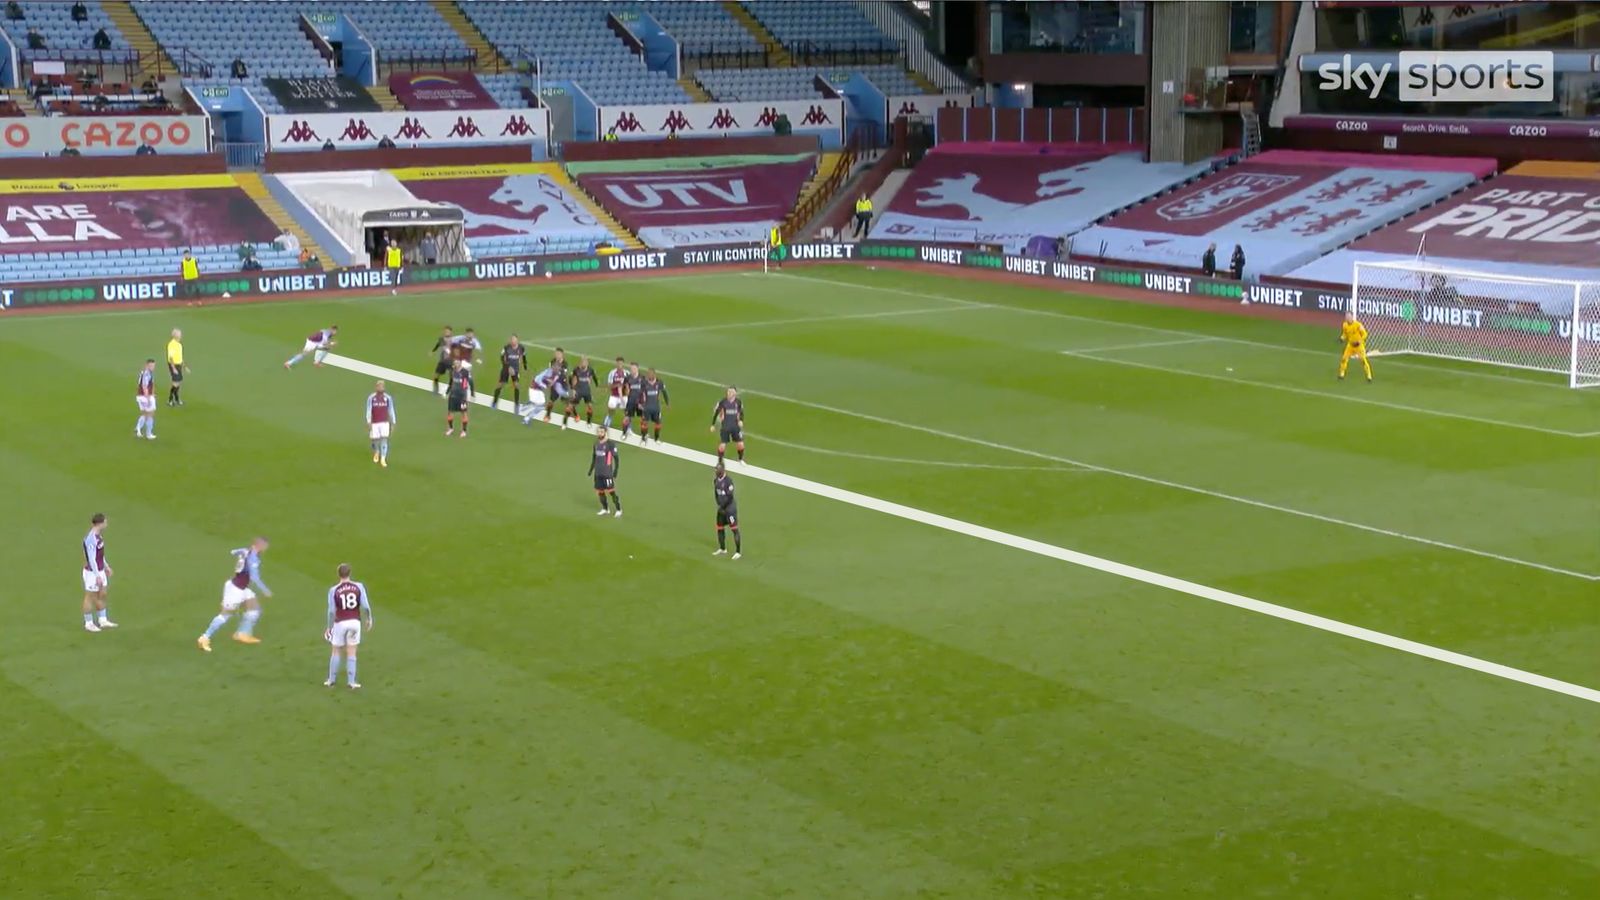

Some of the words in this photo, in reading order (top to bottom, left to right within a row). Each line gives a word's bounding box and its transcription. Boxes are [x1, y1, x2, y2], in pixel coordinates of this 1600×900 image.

[61, 122, 191, 147] CAZOO
[1336, 121, 1368, 131] CAZOO
[1509, 125, 1547, 136] CAZOO
[606, 179, 748, 208] UTV
[1472, 188, 1587, 207] PART
[7, 204, 96, 221] ARE
[683, 251, 711, 264] STAY
[712, 250, 723, 262] IN
[792, 244, 854, 259] UNIBET
[921, 246, 962, 265] UNIBET
[475, 261, 537, 278] UNIBET
[608, 252, 667, 270] UNIBET
[1006, 256, 1047, 275] UNIBET
[337, 270, 402, 288] UNIBE
[1053, 260, 1096, 282] UNIBET
[103, 281, 177, 300] UNIBET
[258, 274, 326, 292] UNIBET
[1145, 273, 1192, 293] UNIBET
[1250, 286, 1302, 307] UNIBET
[1318, 295, 1344, 310] STAY
[1423, 305, 1483, 328] UNIBET
[340, 592, 358, 610] 18
